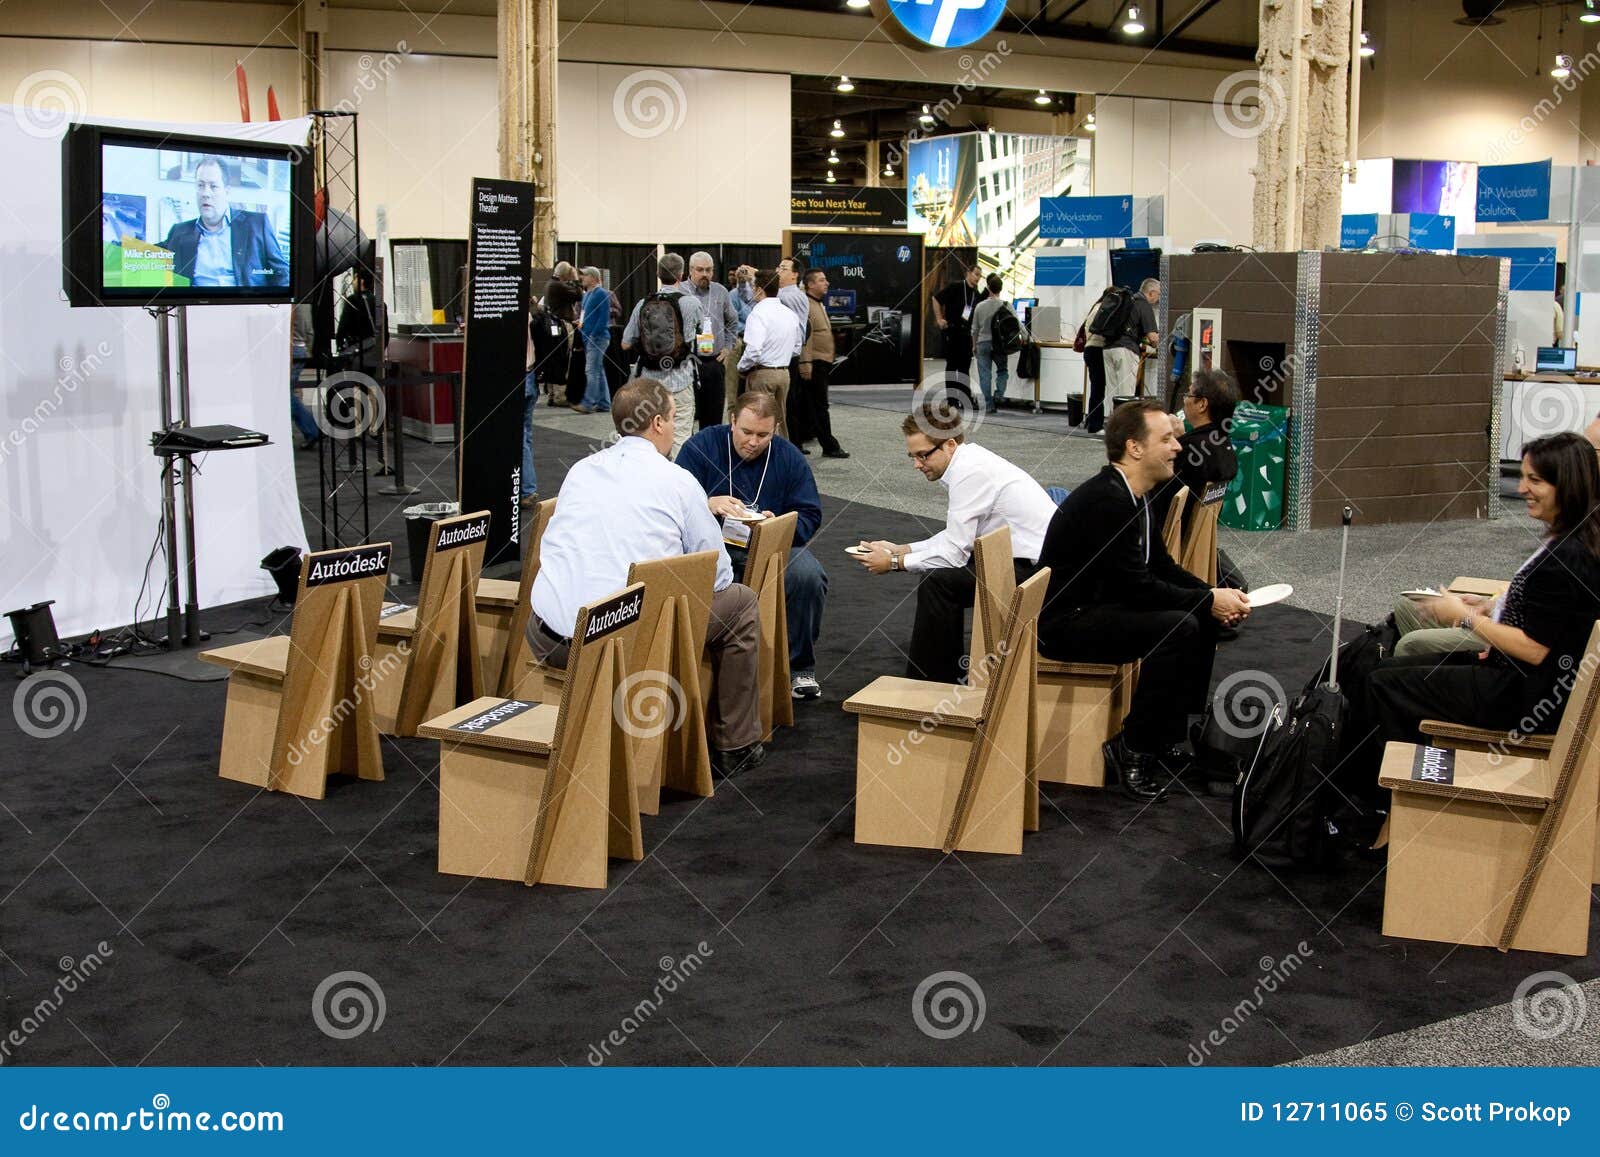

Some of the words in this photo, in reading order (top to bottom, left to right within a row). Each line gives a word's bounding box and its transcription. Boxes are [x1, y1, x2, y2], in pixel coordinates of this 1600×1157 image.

[479, 192, 498, 205] Design
[498, 194, 519, 204] Matters
[1480, 187, 1493, 198] HP
[1495, 185, 1538, 199] Workstation
[479, 203, 499, 213] Theater
[791, 198, 807, 208] See
[808, 199, 824, 208] You
[825, 199, 847, 209] Next
[848, 200, 867, 209] Year
[1479, 203, 1516, 216] Solutions
[1041, 212, 1054, 221] HP
[1056, 211, 1102, 221] Workstation
[1041, 224, 1078, 234] Solutions
[124, 249, 143, 258] Mike
[144, 249, 176, 259] Gardner
[897, 246, 910, 262] hp
[510, 466, 520, 544] Autodesk
[437, 520, 487, 546] Autodesk
[309, 551, 387, 580] Autodesk
[585, 594, 641, 638] Autodesk
[458, 700, 529, 730] Autodesk
[1421, 745, 1448, 782] Autodesk
